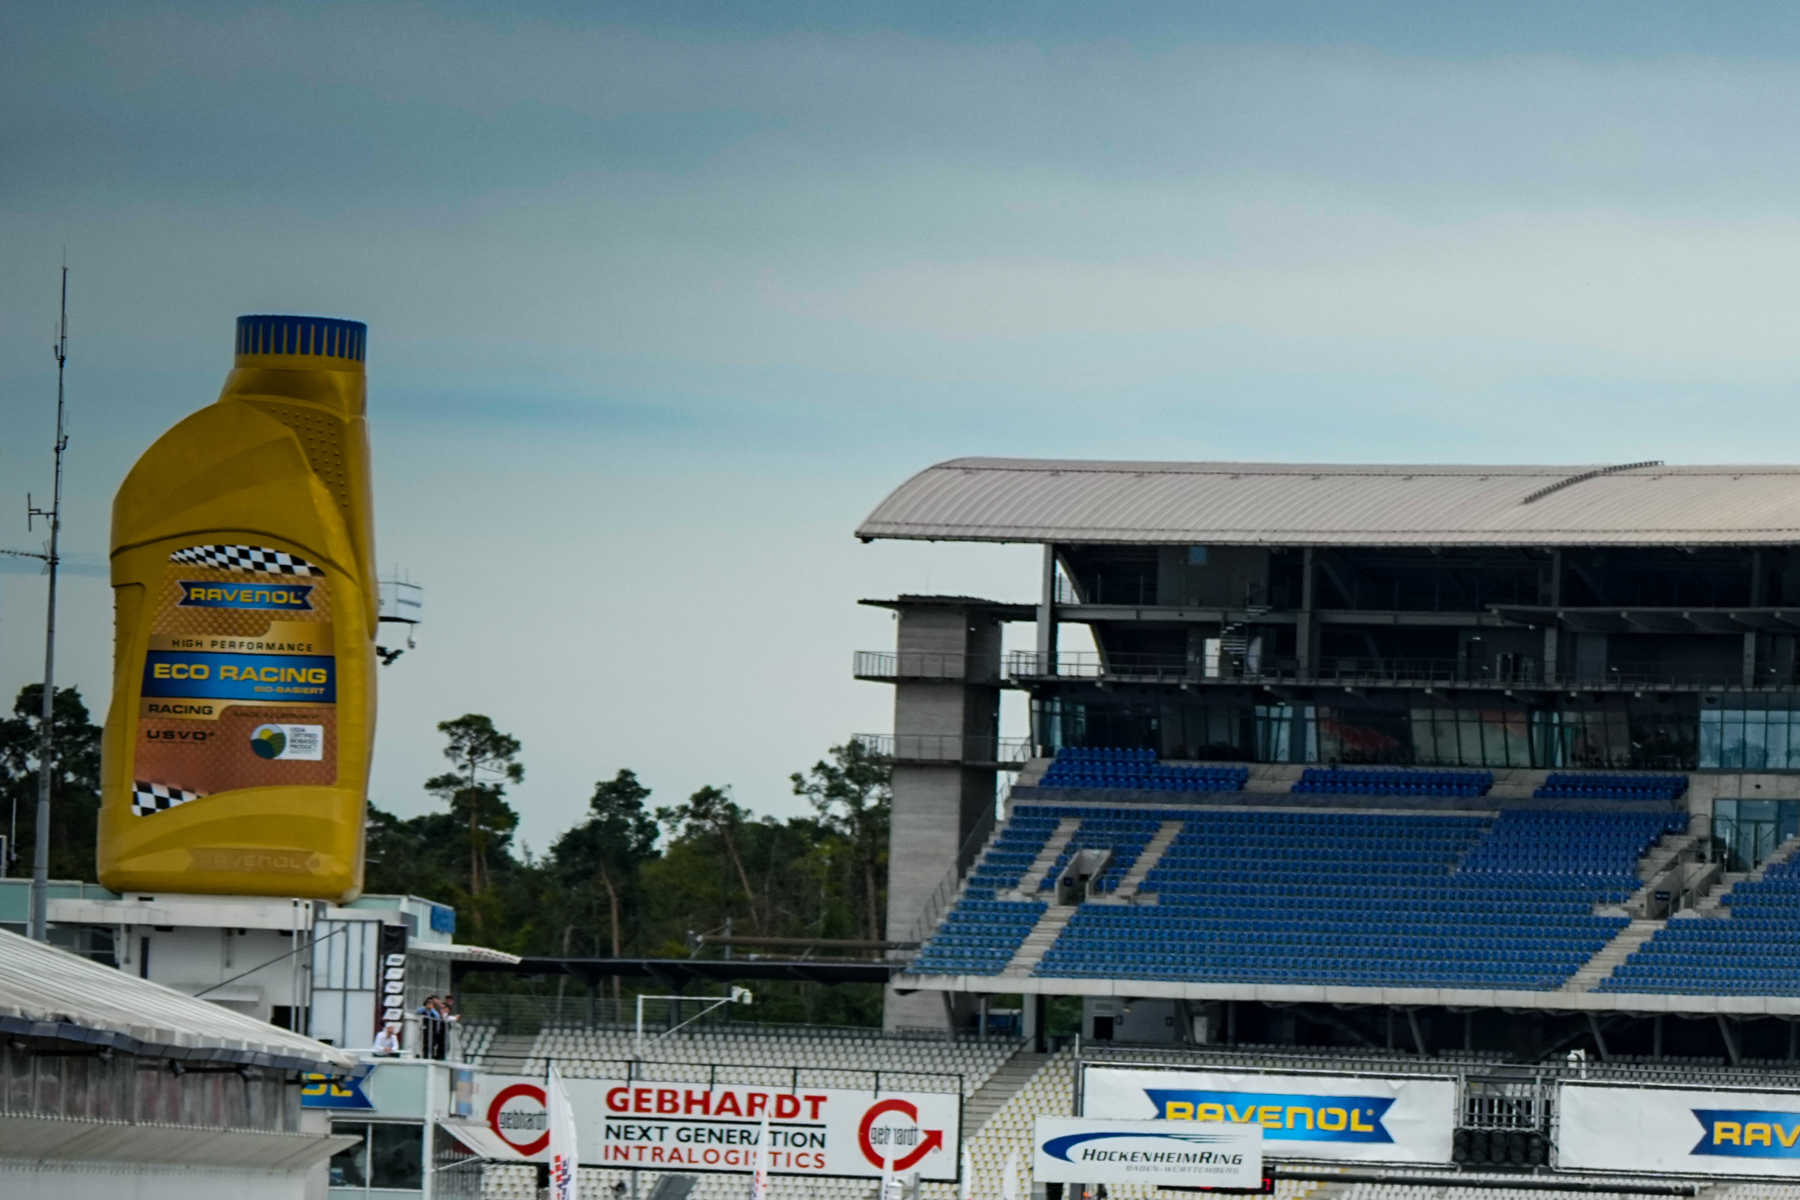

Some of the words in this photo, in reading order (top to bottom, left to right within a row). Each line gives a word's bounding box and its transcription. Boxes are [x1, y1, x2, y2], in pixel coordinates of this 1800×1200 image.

[189, 587, 303, 605] RAVENOL
[172, 639, 204, 648] HIGH
[210, 640, 313, 652] PERFORMANCE
[153, 663, 210, 680] ECO
[219, 665, 327, 684] RACING
[148, 703, 214, 716] RACING
[605, 1086, 828, 1120] GEBHARDT
[1166, 1101, 1374, 1133] RAVENOL
[605, 1124, 669, 1142] NEXT
